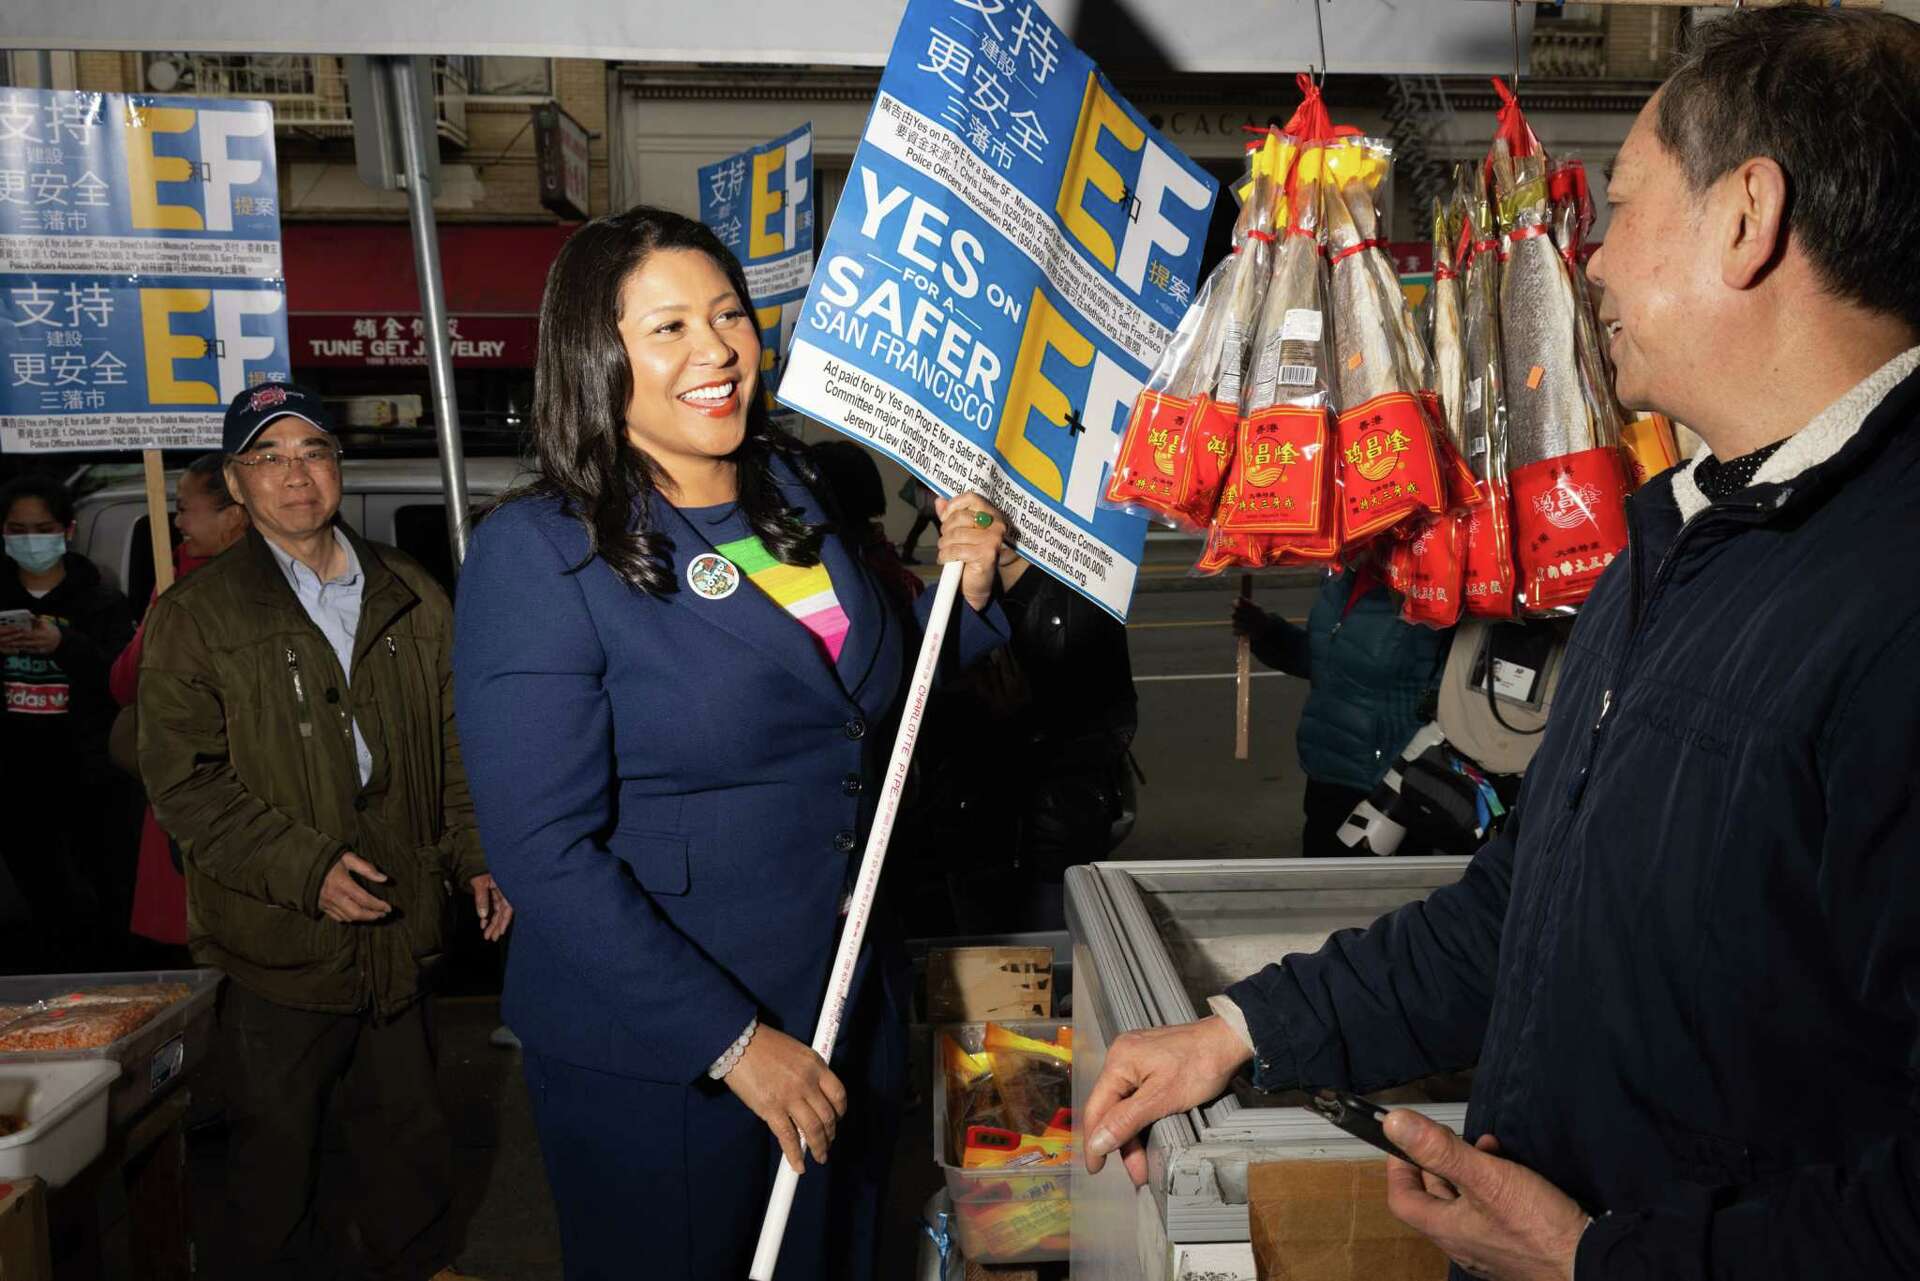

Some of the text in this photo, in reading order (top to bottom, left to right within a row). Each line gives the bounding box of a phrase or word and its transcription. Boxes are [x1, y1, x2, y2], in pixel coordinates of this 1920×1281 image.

[916, 26, 1050, 165] 更安全
[940, 95, 1016, 171] 三藩市
[0, 169, 111, 207] 更安全
[905, 147, 932, 170] Police
[933, 162, 961, 192] Officers
[962, 186, 1001, 226] Association
[1001, 218, 1018, 238] PAC
[929, 127, 941, 140] on
[942, 133, 961, 155] Prop
[960, 148, 966, 160] E
[966, 154, 976, 168] for
[981, 167, 1001, 188] Safer
[1000, 183, 1012, 198] SF
[1014, 194, 1036, 218] Mayor
[860, 165, 986, 299] YES
[986, 283, 1023, 324] ON
[960, 166, 978, 189] Chris
[978, 182, 1002, 208] Larsen
[1117, 314, 1130, 332] San
[1130, 324, 1161, 354] Francisco
[10, 281, 116, 328] 支持
[819, 255, 1001, 404] SAFER
[902, 267, 956, 313] FOR A
[9, 350, 128, 386] 更安全
[46, 330, 83, 348] 建設
[309, 340, 364, 357] TUNE
[370, 340, 410, 357] GET
[810, 301, 994, 432] SAN FRANCISCO
[39, 389, 106, 410] 三藩市
[823, 360, 840, 377] Ad
[837, 369, 861, 388] paid
[860, 377, 875, 395] for
[874, 384, 887, 404] by
[887, 391, 903, 411] Yes
[903, 404, 915, 418] on
[914, 409, 932, 434] Prop
[931, 423, 940, 438] E
[939, 427, 950, 444] for
[949, 439, 955, 449] a
[955, 440, 977, 463] Safer
[975, 453, 988, 470] SF
[1004, 481, 1027, 510] Breed's
[1028, 500, 1048, 525] Ballot
[1048, 514, 1077, 544] Measure
[825, 379, 874, 414] Committee
[874, 407, 901, 428] major
[900, 418, 928, 452] funding
[927, 440, 948, 464] from:
[947, 454, 967, 478] Chris
[968, 467, 991, 493] Larsen
[1019, 513, 1044, 539] Ronald
[1044, 530, 1073, 560] Conway
[843, 408, 878, 439] Jeremy
[878, 425, 900, 448] Liew
[932, 463, 967, 495] Financial
[1039, 546, 1047, 559] at
[901, 683, 928, 760] CHARLOTTE
